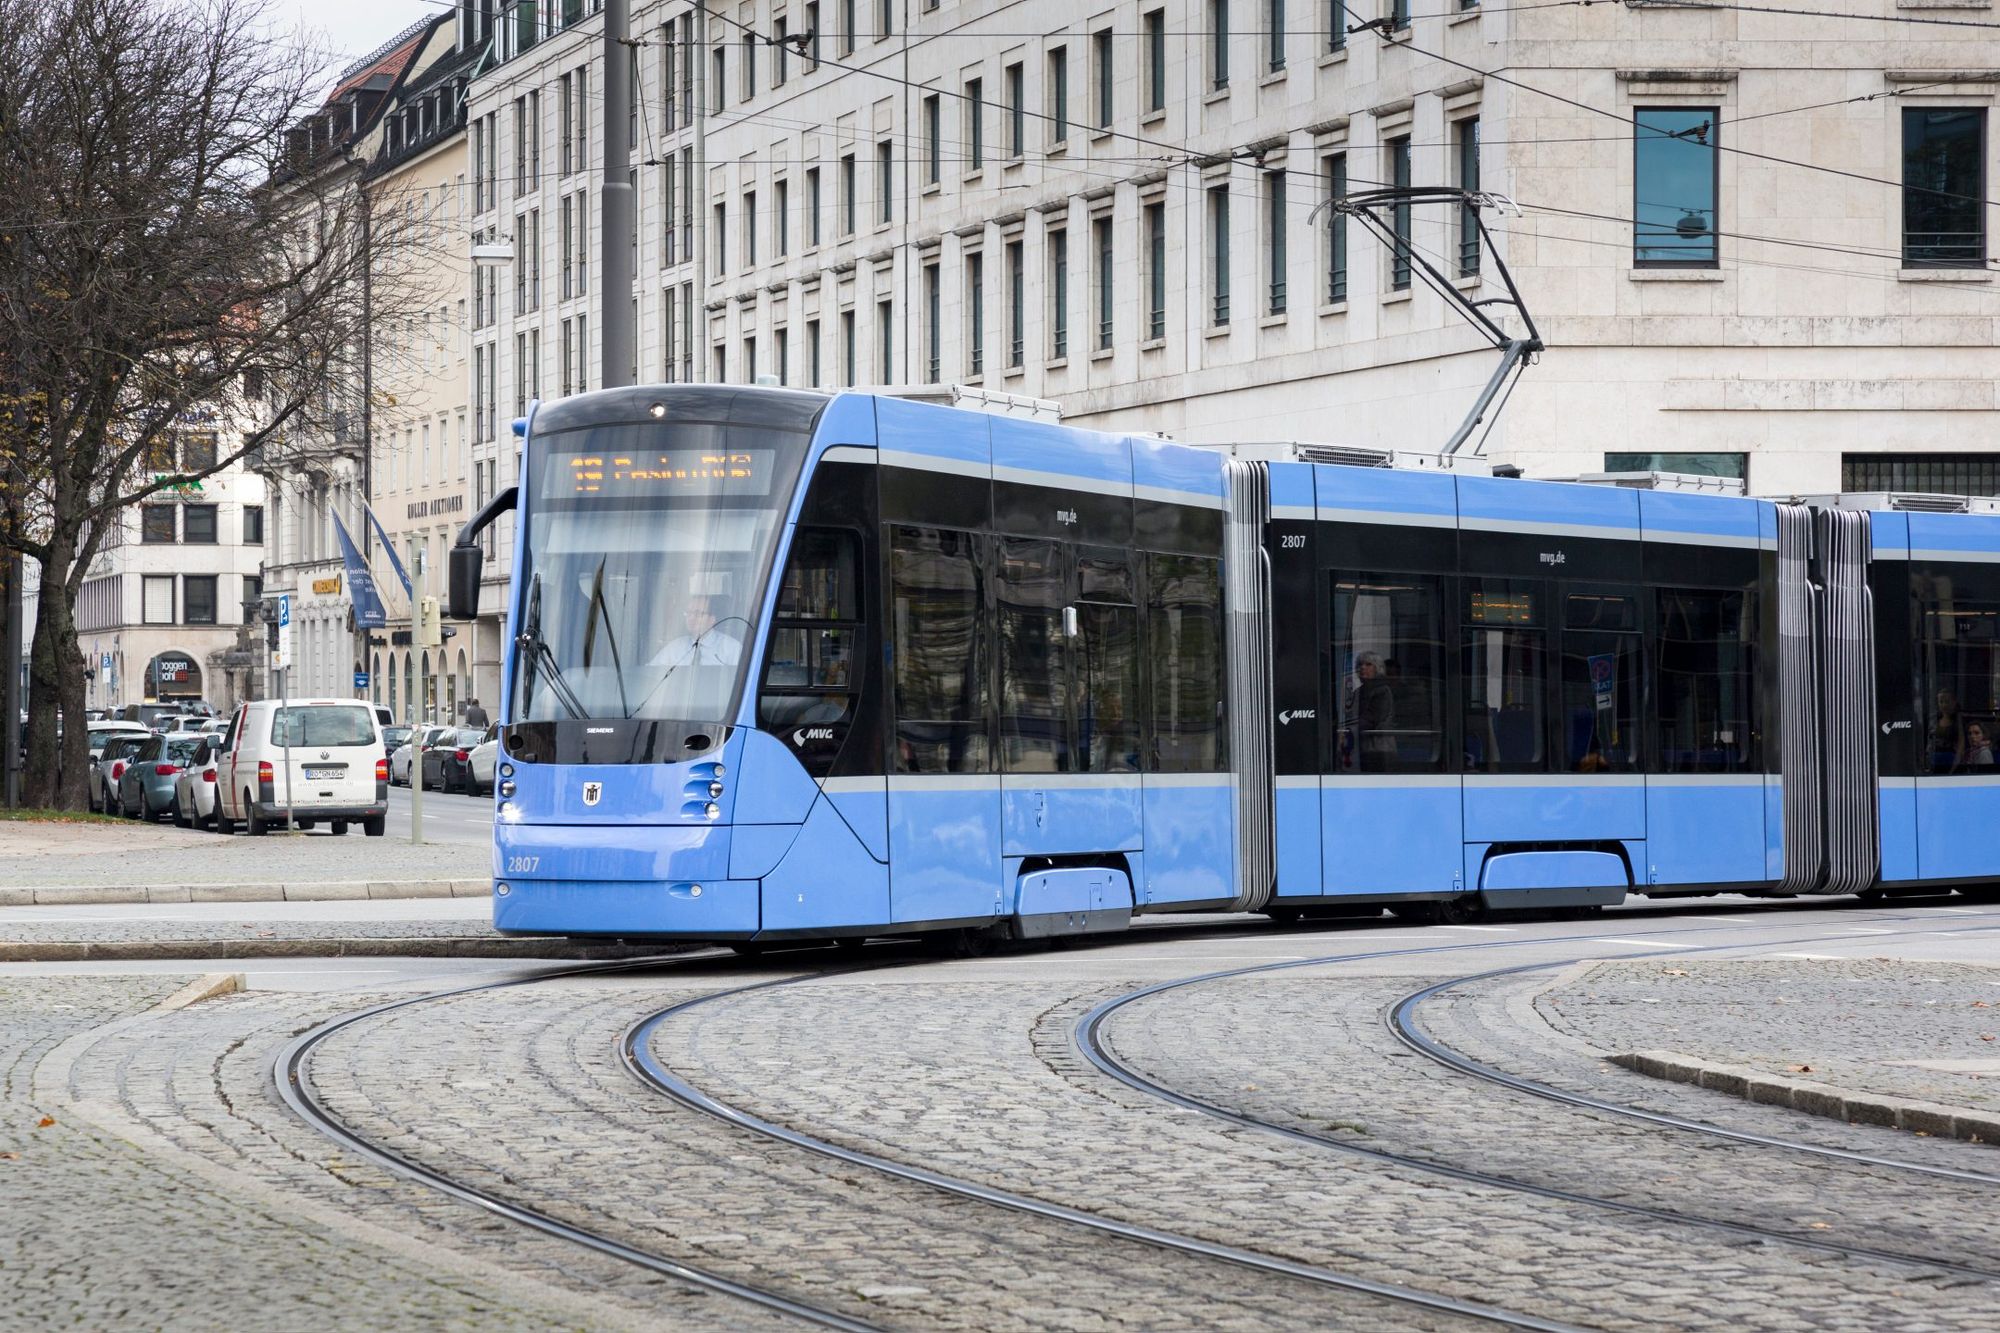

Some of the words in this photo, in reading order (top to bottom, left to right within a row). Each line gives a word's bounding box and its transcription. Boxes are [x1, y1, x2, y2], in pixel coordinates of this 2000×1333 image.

[1056, 507, 1077, 526] mvg.de
[1281, 535, 1306, 548] 2807
[1540, 550, 1566, 566] mvg.de
[1290, 709, 1315, 719] MVG
[1891, 720, 1912, 729] MVG
[805, 728, 833, 739] MVG
[507, 856, 540, 873] 2807
